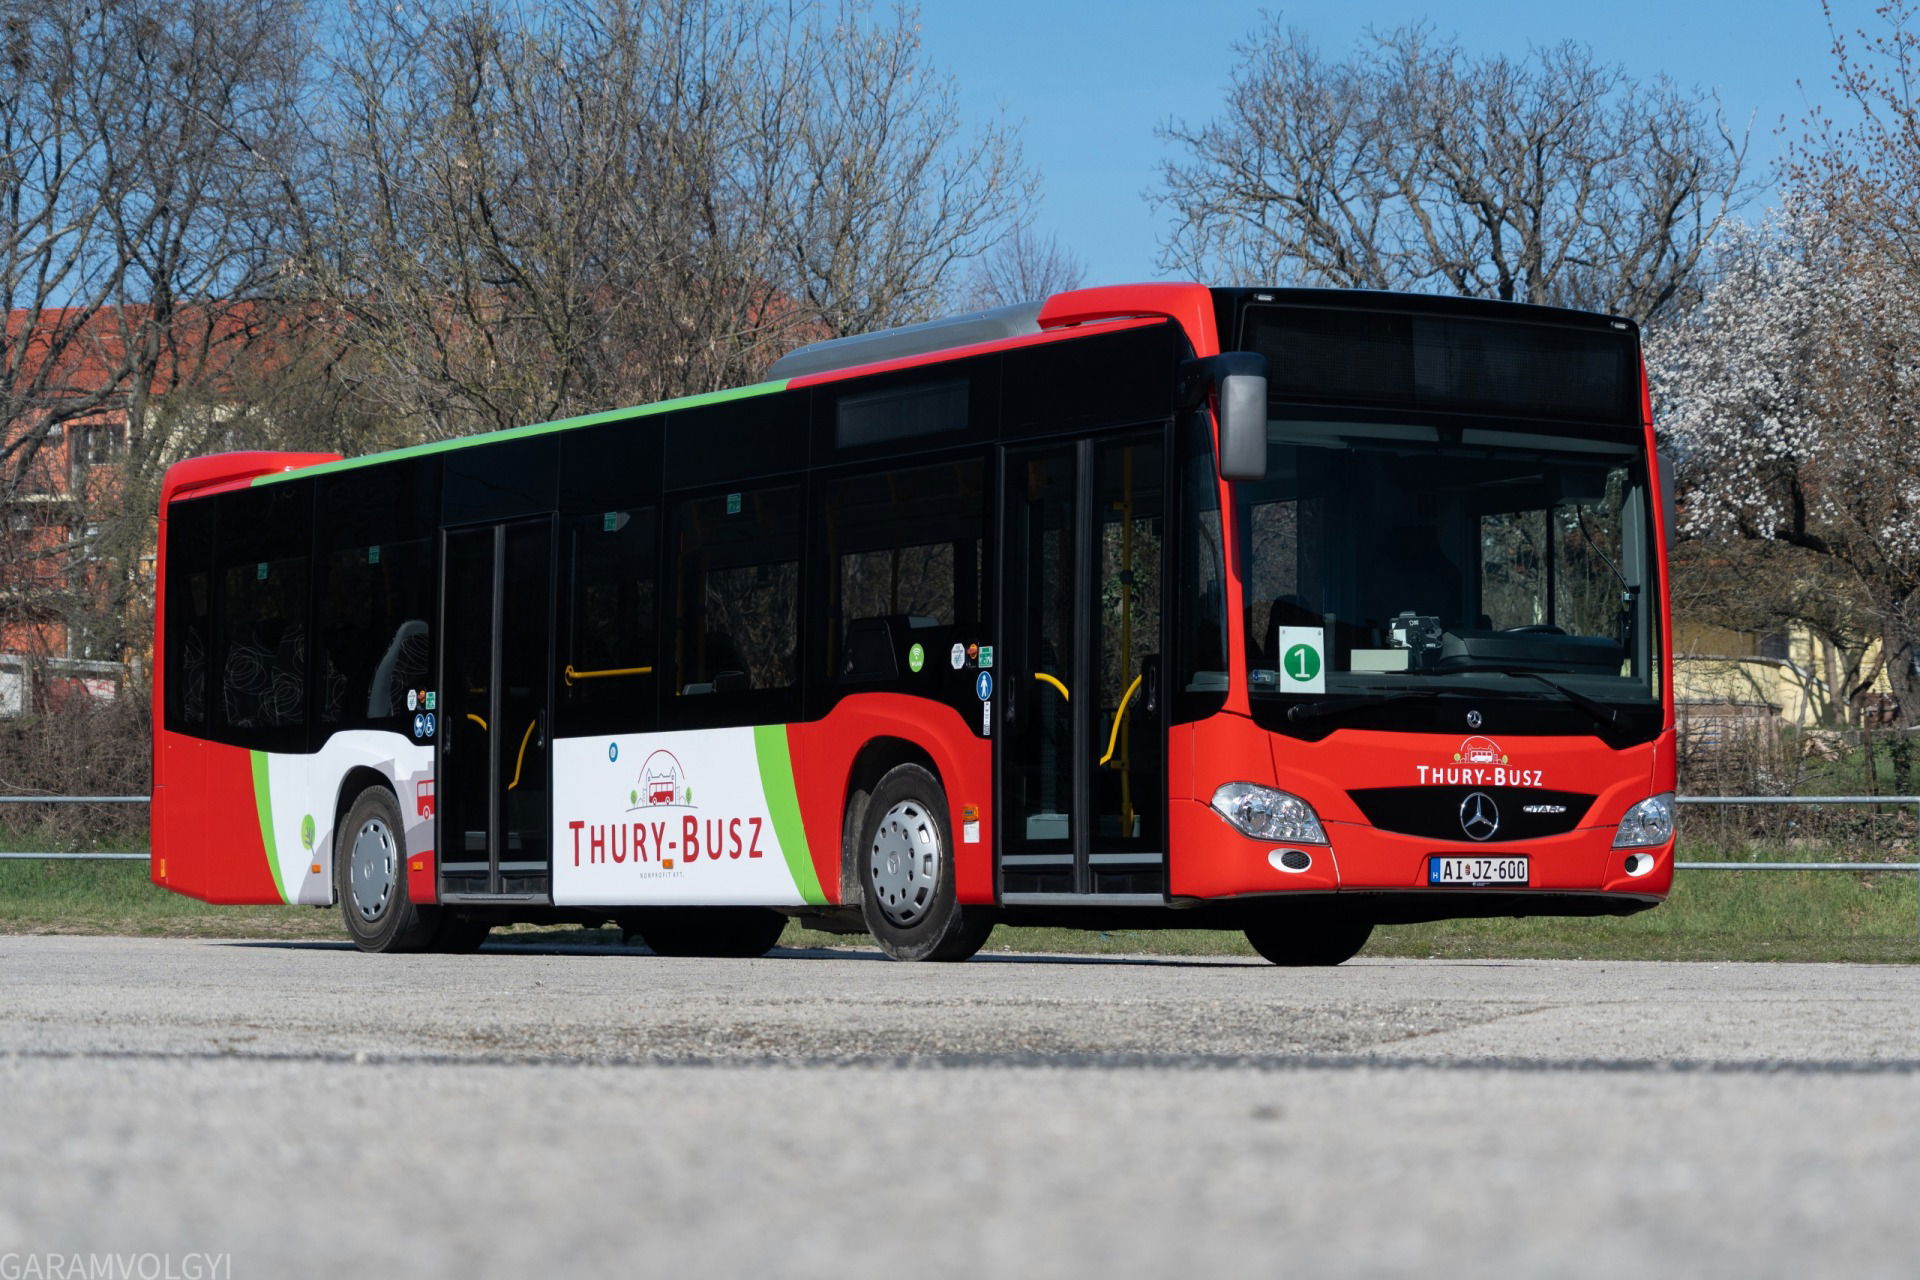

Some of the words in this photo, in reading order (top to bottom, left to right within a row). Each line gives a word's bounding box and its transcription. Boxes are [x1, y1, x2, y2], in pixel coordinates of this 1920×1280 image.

[1294, 648, 1310, 678] 1
[1417, 765, 1543, 787] THURY-BUSZ
[1523, 804, 1567, 814] CITARO
[569, 815, 763, 867] THURY-BUSZ
[1432, 871, 1439, 879] H
